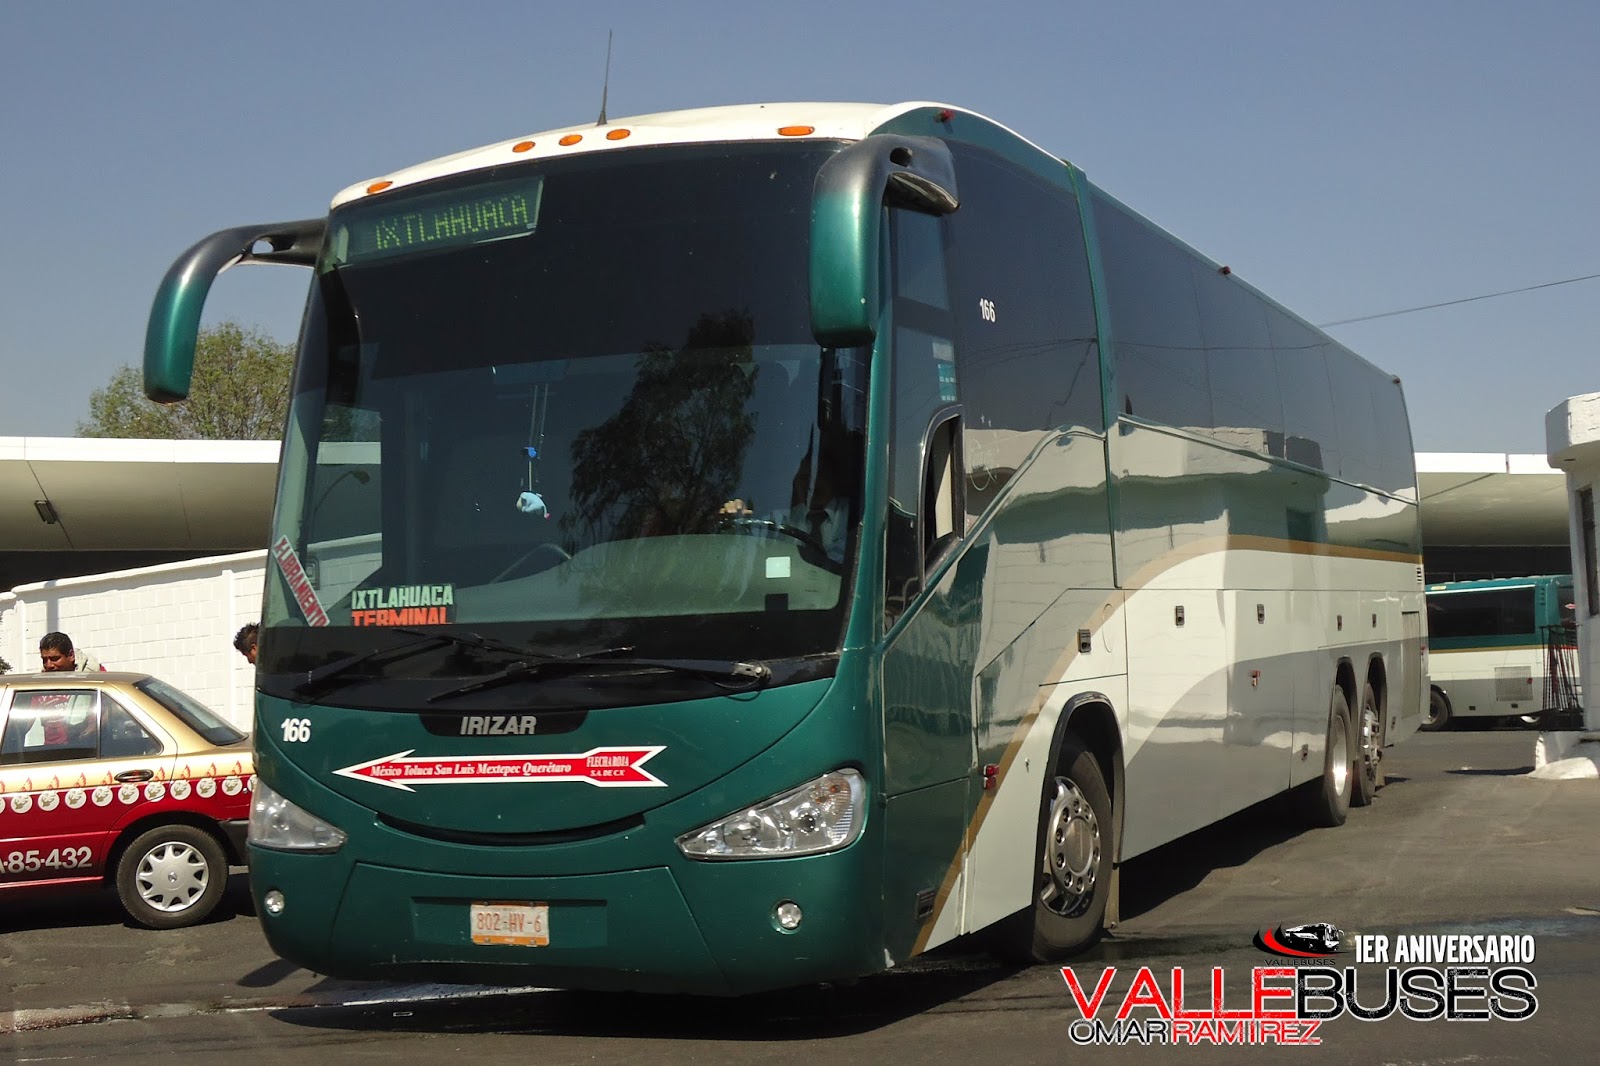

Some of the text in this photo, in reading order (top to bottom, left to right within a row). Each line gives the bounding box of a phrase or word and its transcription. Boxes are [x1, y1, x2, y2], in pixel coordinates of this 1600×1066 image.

[375, 195, 529, 250] IXTLAHUACA
[979, 298, 996, 323] 166
[351, 585, 454, 610] IXTLAHUACA
[352, 607, 453, 627] TERMINAL
[280, 718, 312, 743] 166
[460, 715, 537, 735] IRIZAR
[370, 761, 571, 777] México Toluca San Luis Mextepec Querétaro
[586, 755, 630, 768] FLECHA ROJA
